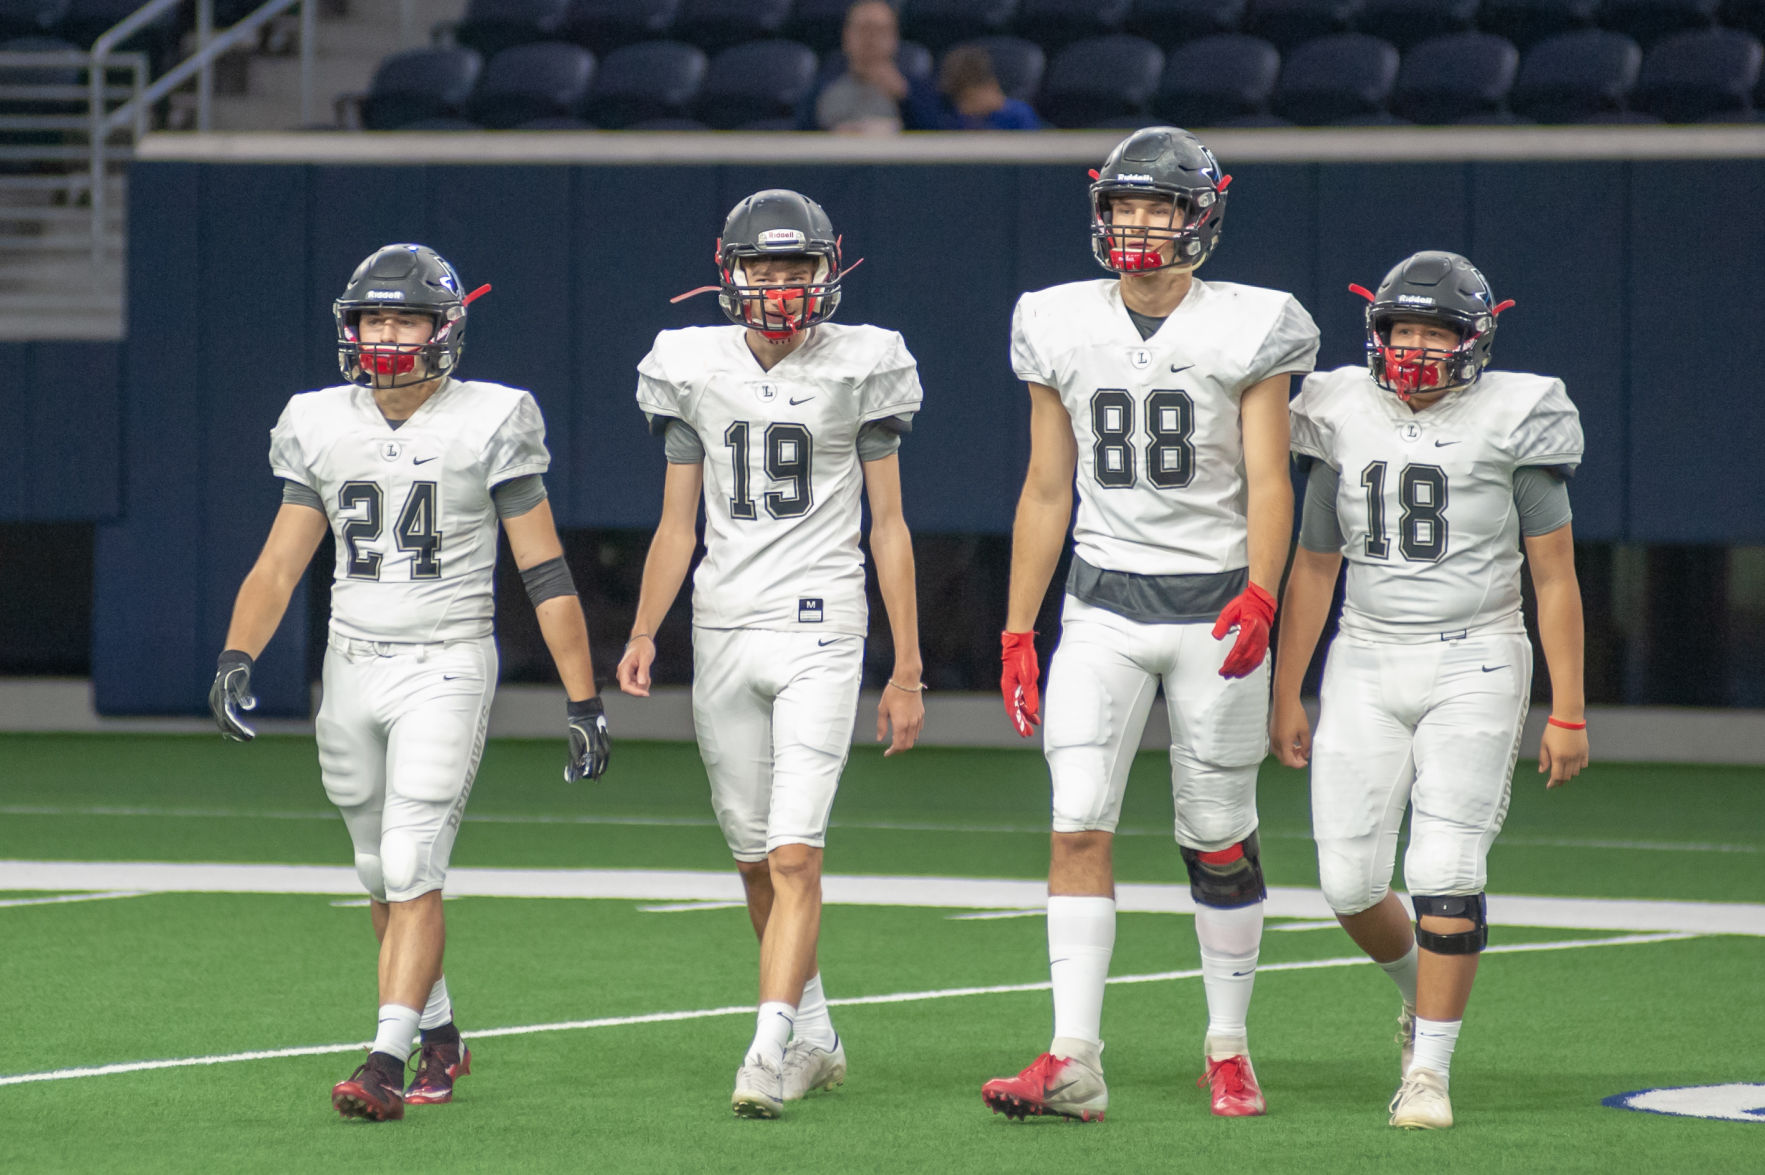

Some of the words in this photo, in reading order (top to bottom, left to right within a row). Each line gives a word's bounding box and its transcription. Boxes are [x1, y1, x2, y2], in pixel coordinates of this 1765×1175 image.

[1138, 352, 1148, 364] L
[762, 385, 773, 397] L
[1408, 424, 1417, 438] L
[1090, 388, 1196, 490] 88
[386, 444, 397, 457] L
[724, 420, 814, 521] 19
[1360, 460, 1449, 563] 18
[337, 480, 443, 582] 24
[806, 600, 816, 609] M
